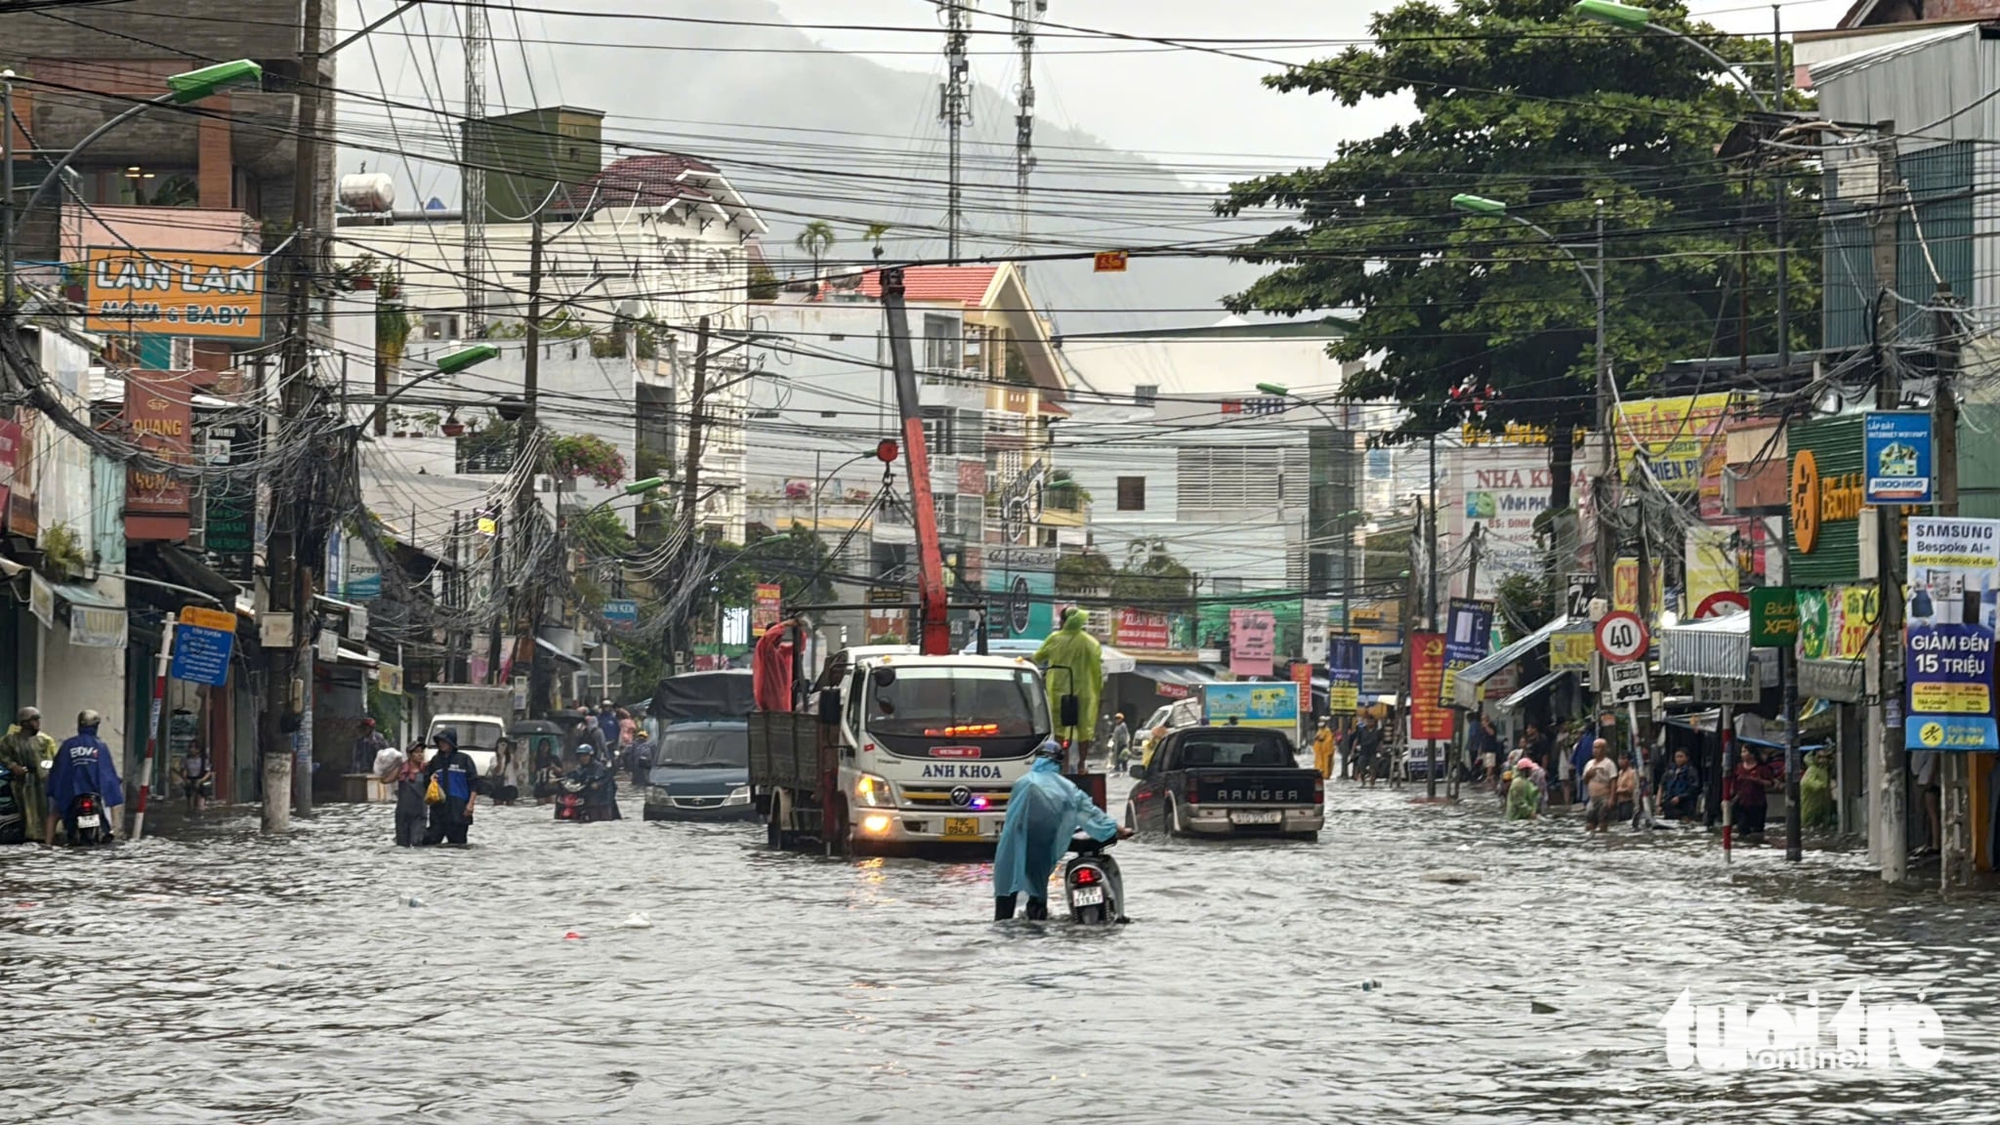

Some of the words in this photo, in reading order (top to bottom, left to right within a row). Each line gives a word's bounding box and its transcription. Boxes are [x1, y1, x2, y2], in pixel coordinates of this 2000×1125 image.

[96, 259, 170, 290] LAN
[181, 263, 256, 295] LAN
[186, 304, 250, 326] BABY
[1476, 469, 1523, 488] NHA
[1916, 524, 1993, 539] SAMSUNG
[1917, 541, 1967, 554] Bespoke
[1609, 624, 1633, 649] 40
[1911, 631, 1956, 651] GIẢM
[1959, 632, 1990, 652] ĐẾN
[1915, 653, 1939, 673] 15
[1942, 654, 1985, 677] TRIỆU
[922, 765, 955, 778] ANH
[959, 765, 1002, 779] KHOA
[1218, 790, 1298, 801] RANGER
